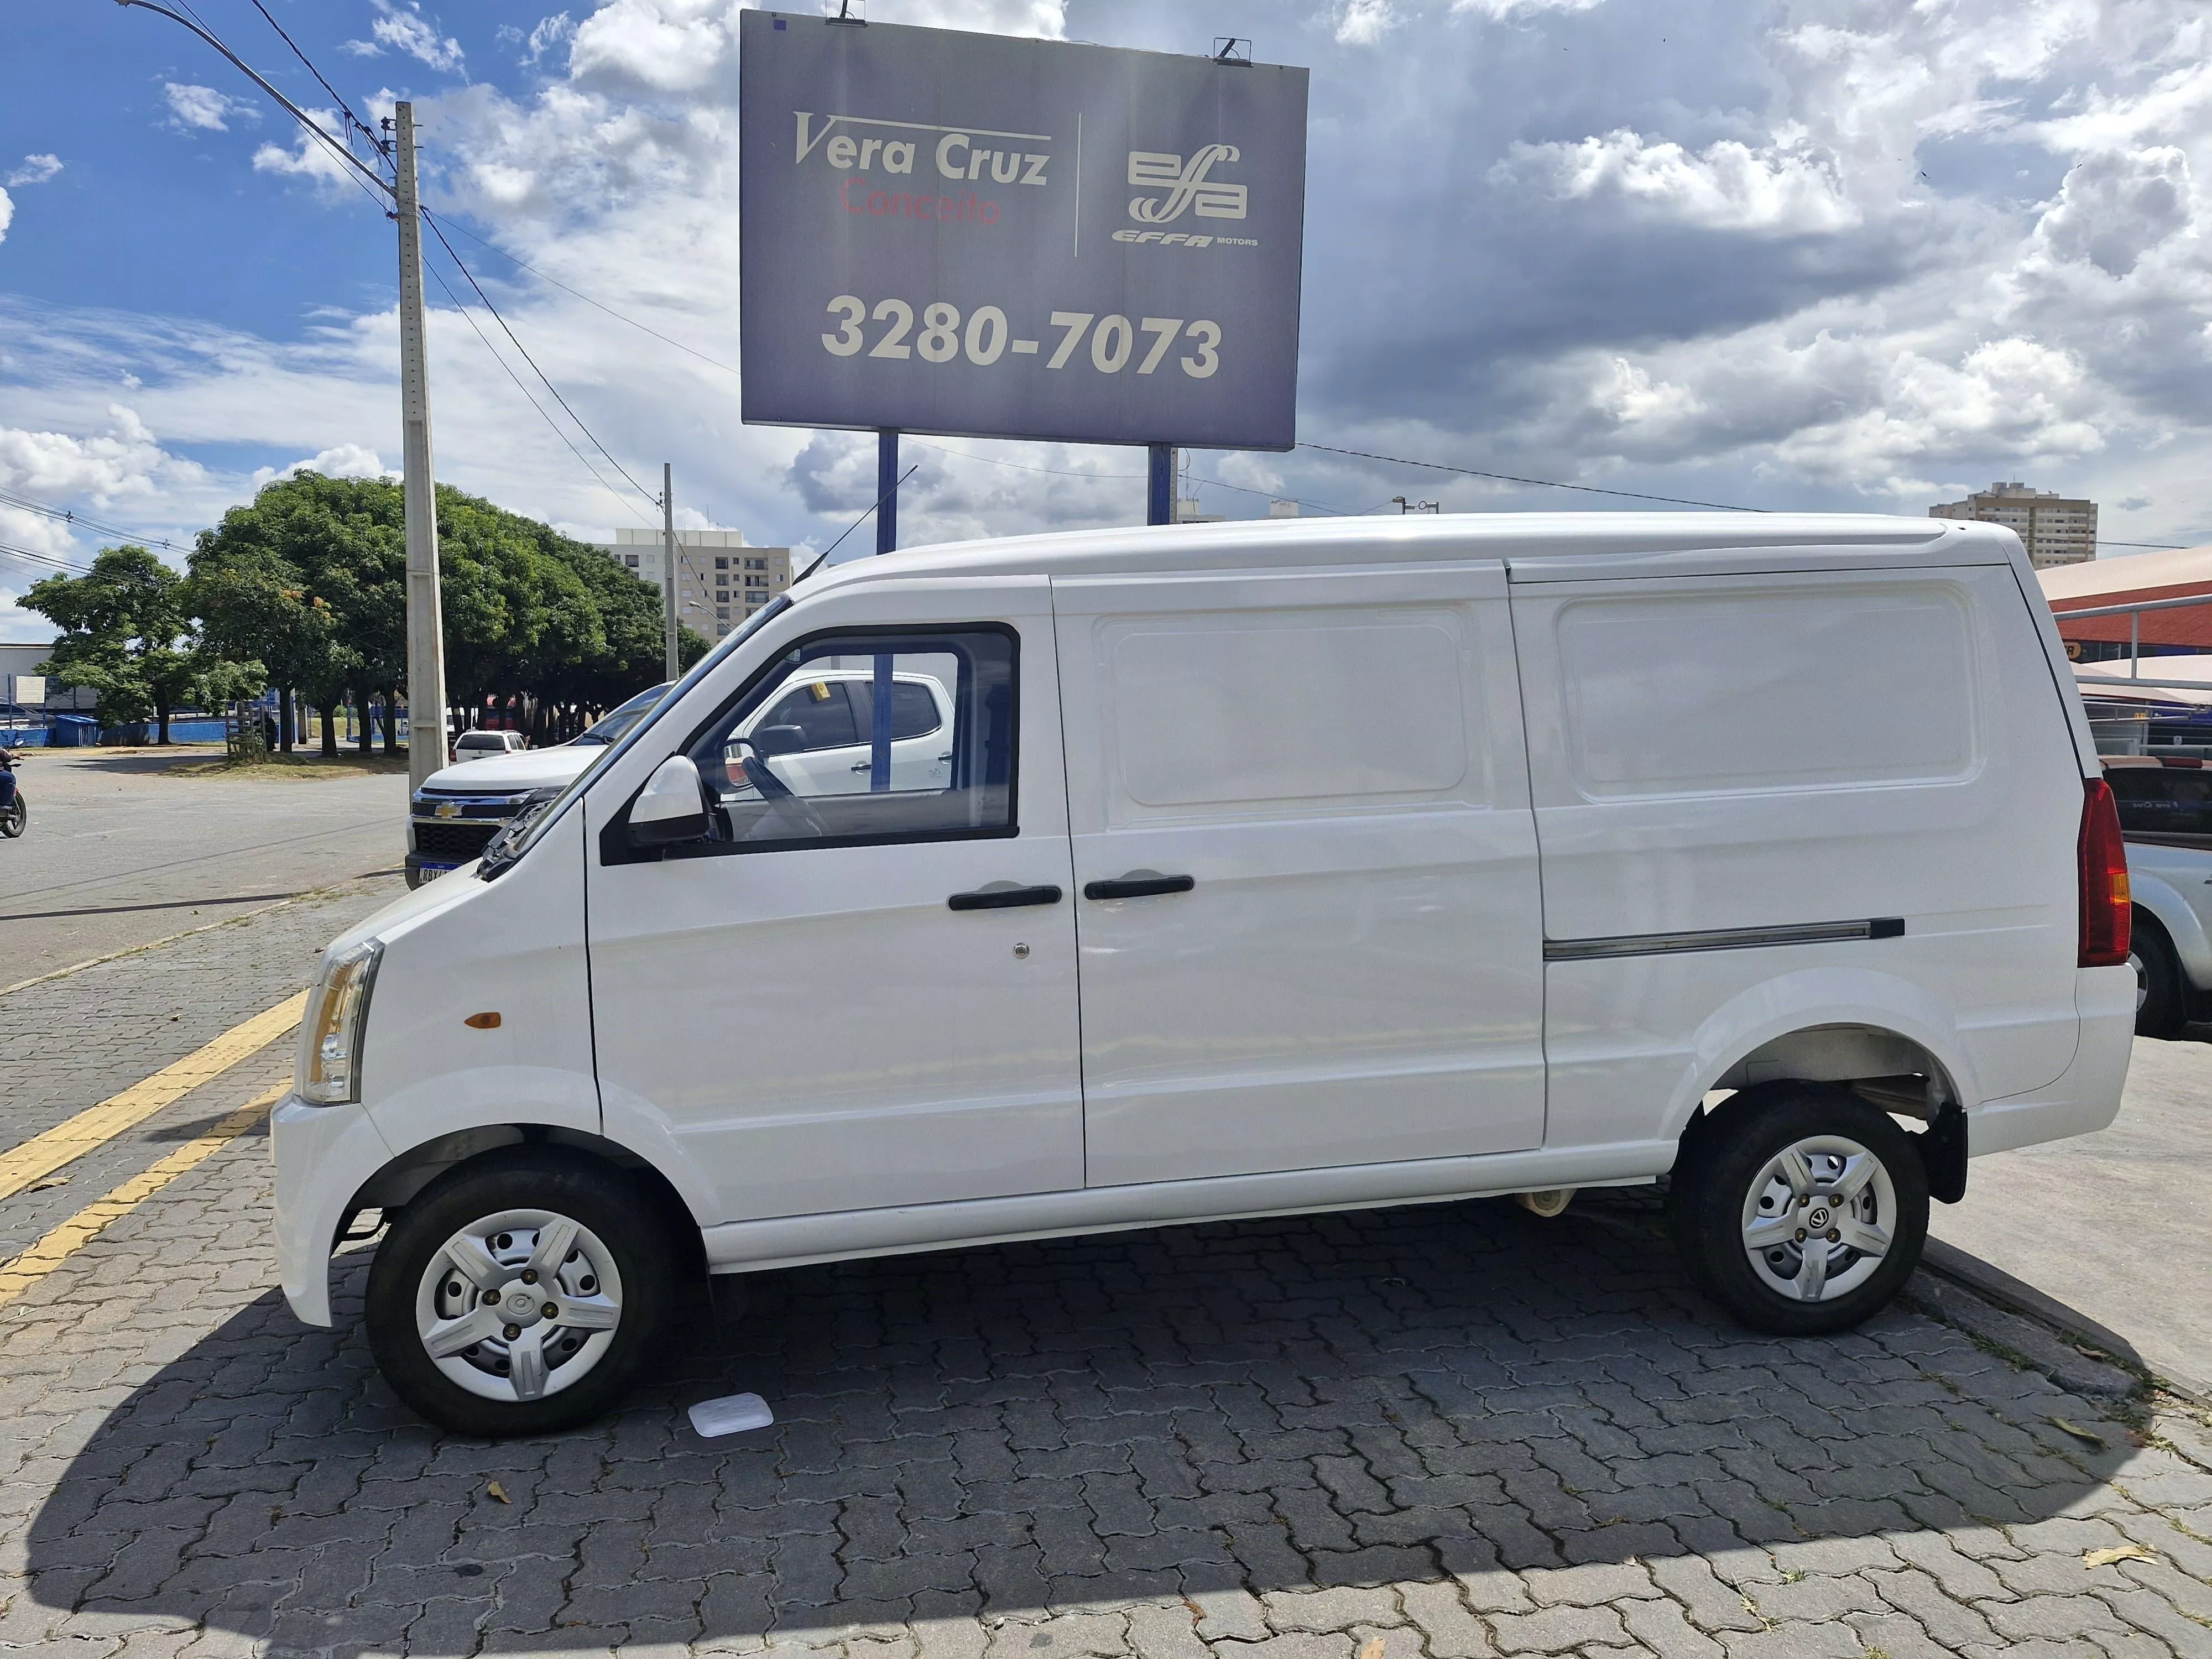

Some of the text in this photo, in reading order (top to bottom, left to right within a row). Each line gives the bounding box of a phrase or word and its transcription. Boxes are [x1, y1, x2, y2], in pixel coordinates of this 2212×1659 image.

[793, 111, 1051, 186] Vera Cruz
[840, 176, 1001, 225] Conceito
[1112, 229, 1258, 248] EFFA MOTORS
[821, 295, 1222, 378] 3280-7073
